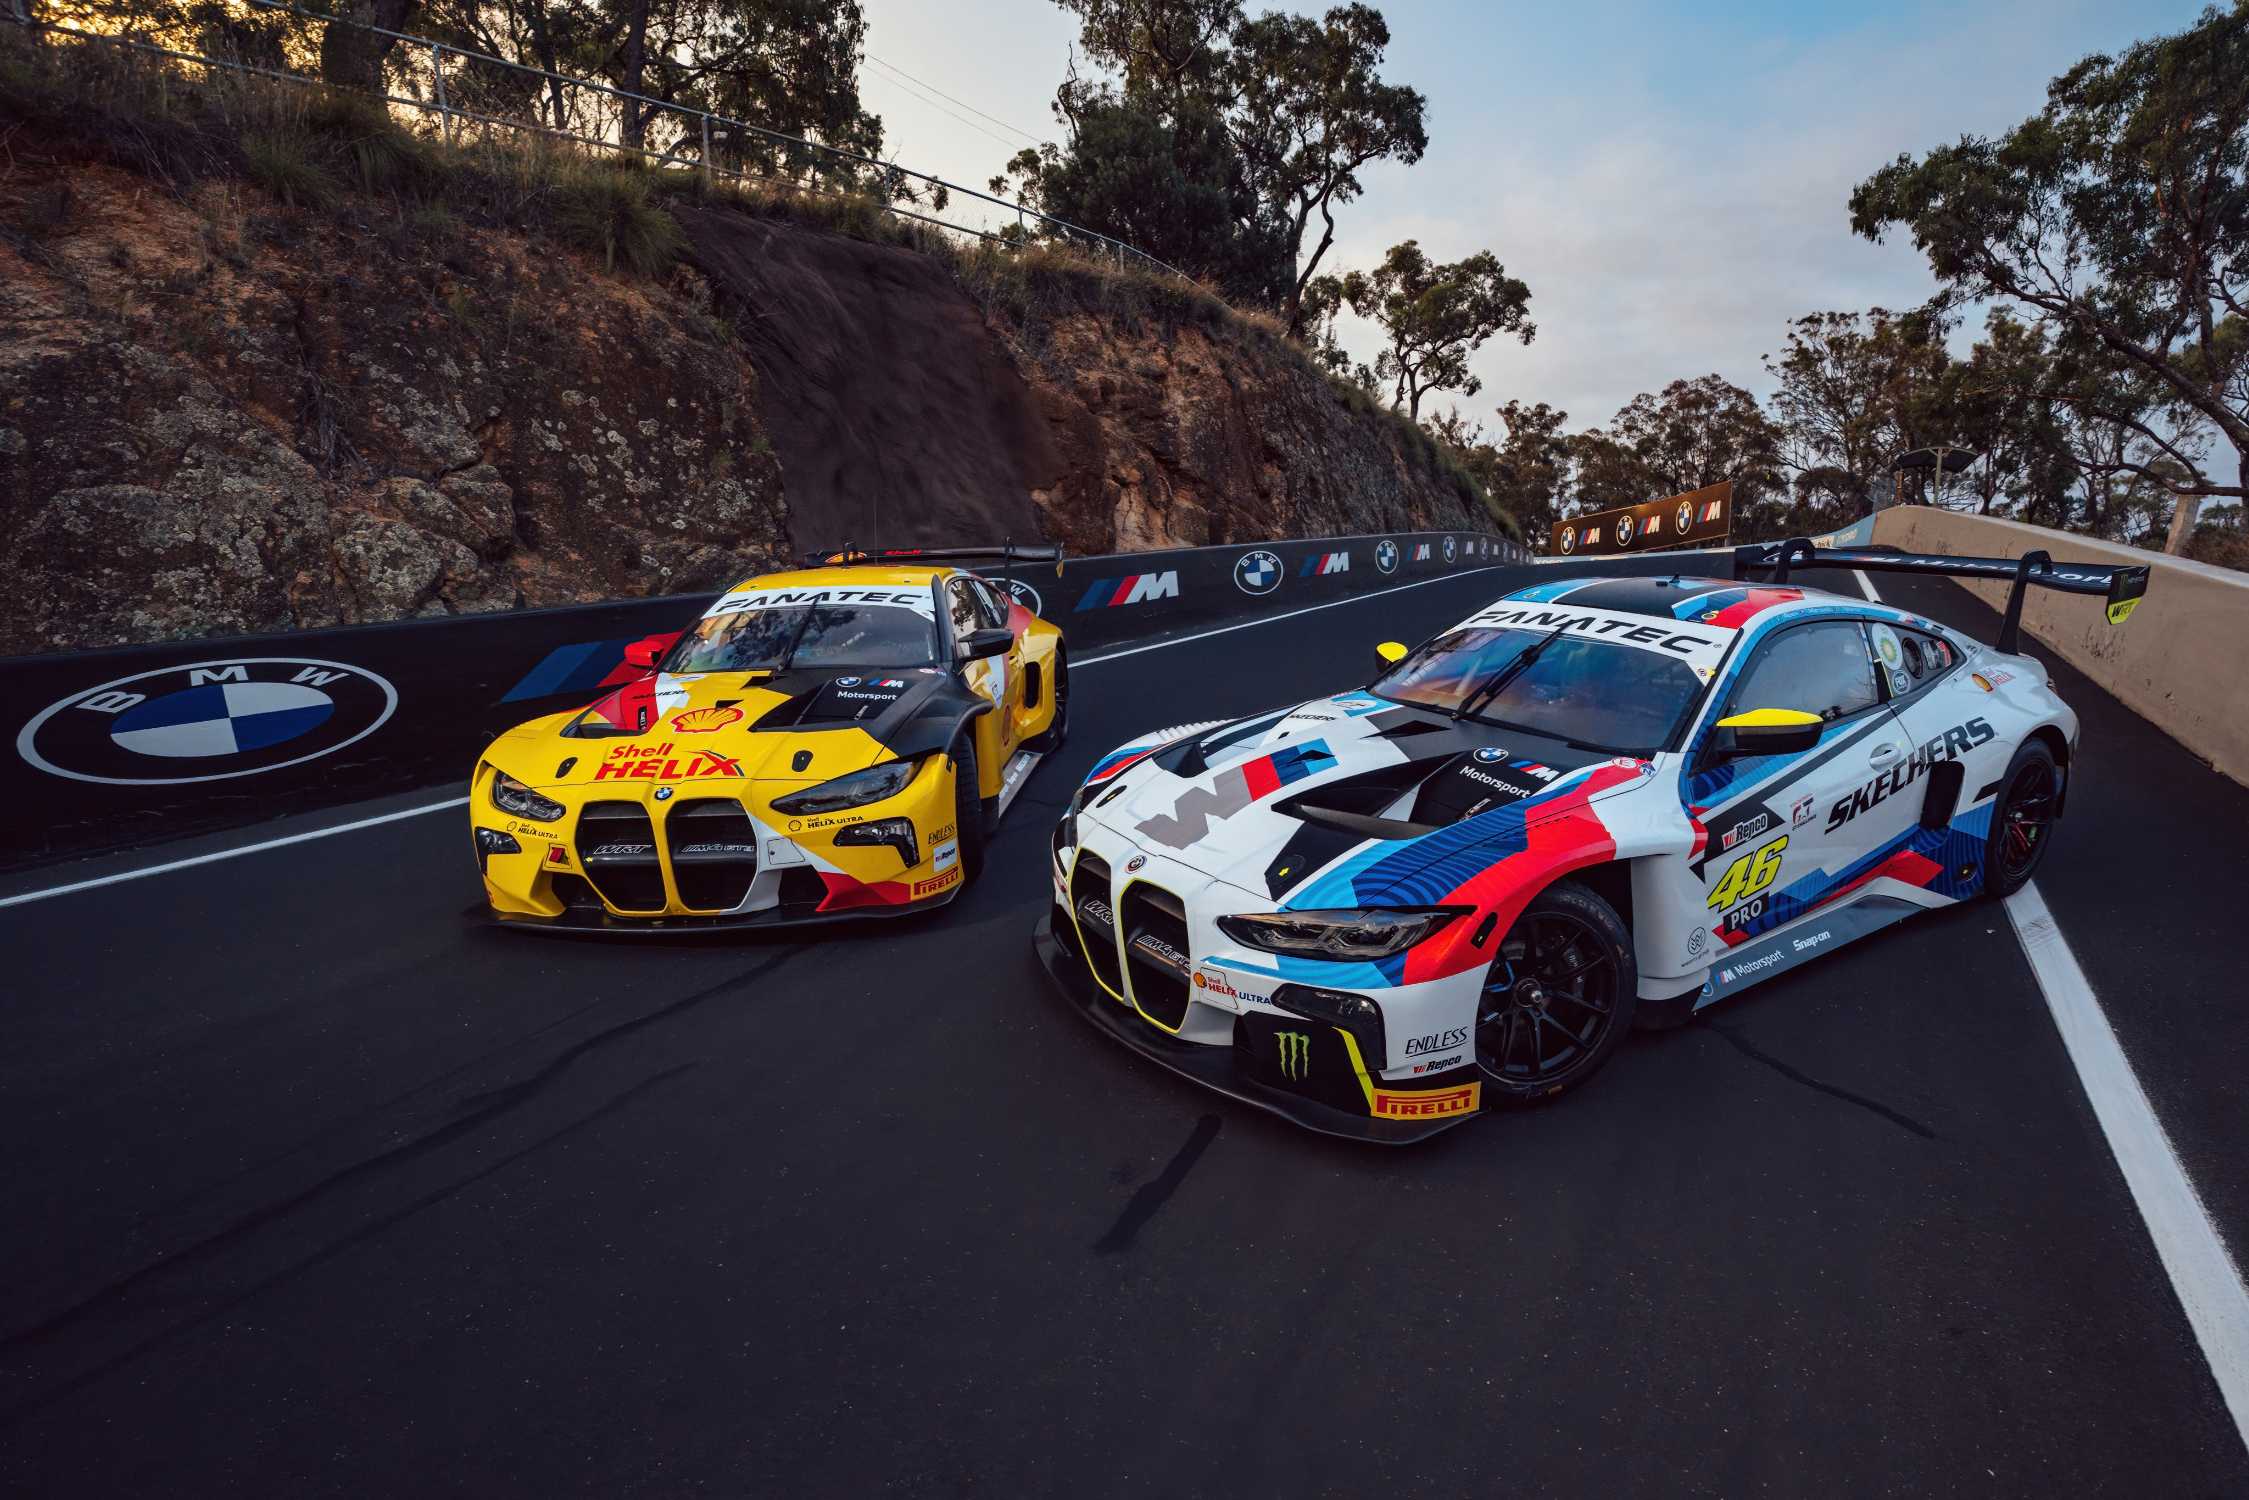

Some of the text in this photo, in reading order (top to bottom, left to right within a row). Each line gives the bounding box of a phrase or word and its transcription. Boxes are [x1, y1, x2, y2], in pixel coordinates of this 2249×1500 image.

[716, 591, 923, 613] FANATEC
[1468, 609, 1713, 654] FANATEC
[75, 665, 349, 715] BMW
[837, 690, 897, 700] Motorsport
[609, 743, 674, 760] Shell
[594, 750, 746, 781] HELIX
[1823, 716, 1996, 835] SKECHERS
[1460, 765, 1531, 799] Motorsport
[808, 818, 835, 829] HELIX
[1736, 814, 1767, 841] Repco
[914, 866, 959, 895] PIRELLI
[1707, 833, 1789, 912] 46
[1730, 900, 1763, 931] PRO
[1792, 929, 1831, 951] Snap-on
[1735, 950, 1785, 977] Motorsport
[1208, 983, 1272, 1005] HELIX ULTRA
[1405, 1026, 1468, 1057] ENDLESS
[1426, 1055, 1462, 1072] Repco
[1376, 1089, 1474, 1116] PIRELLI
